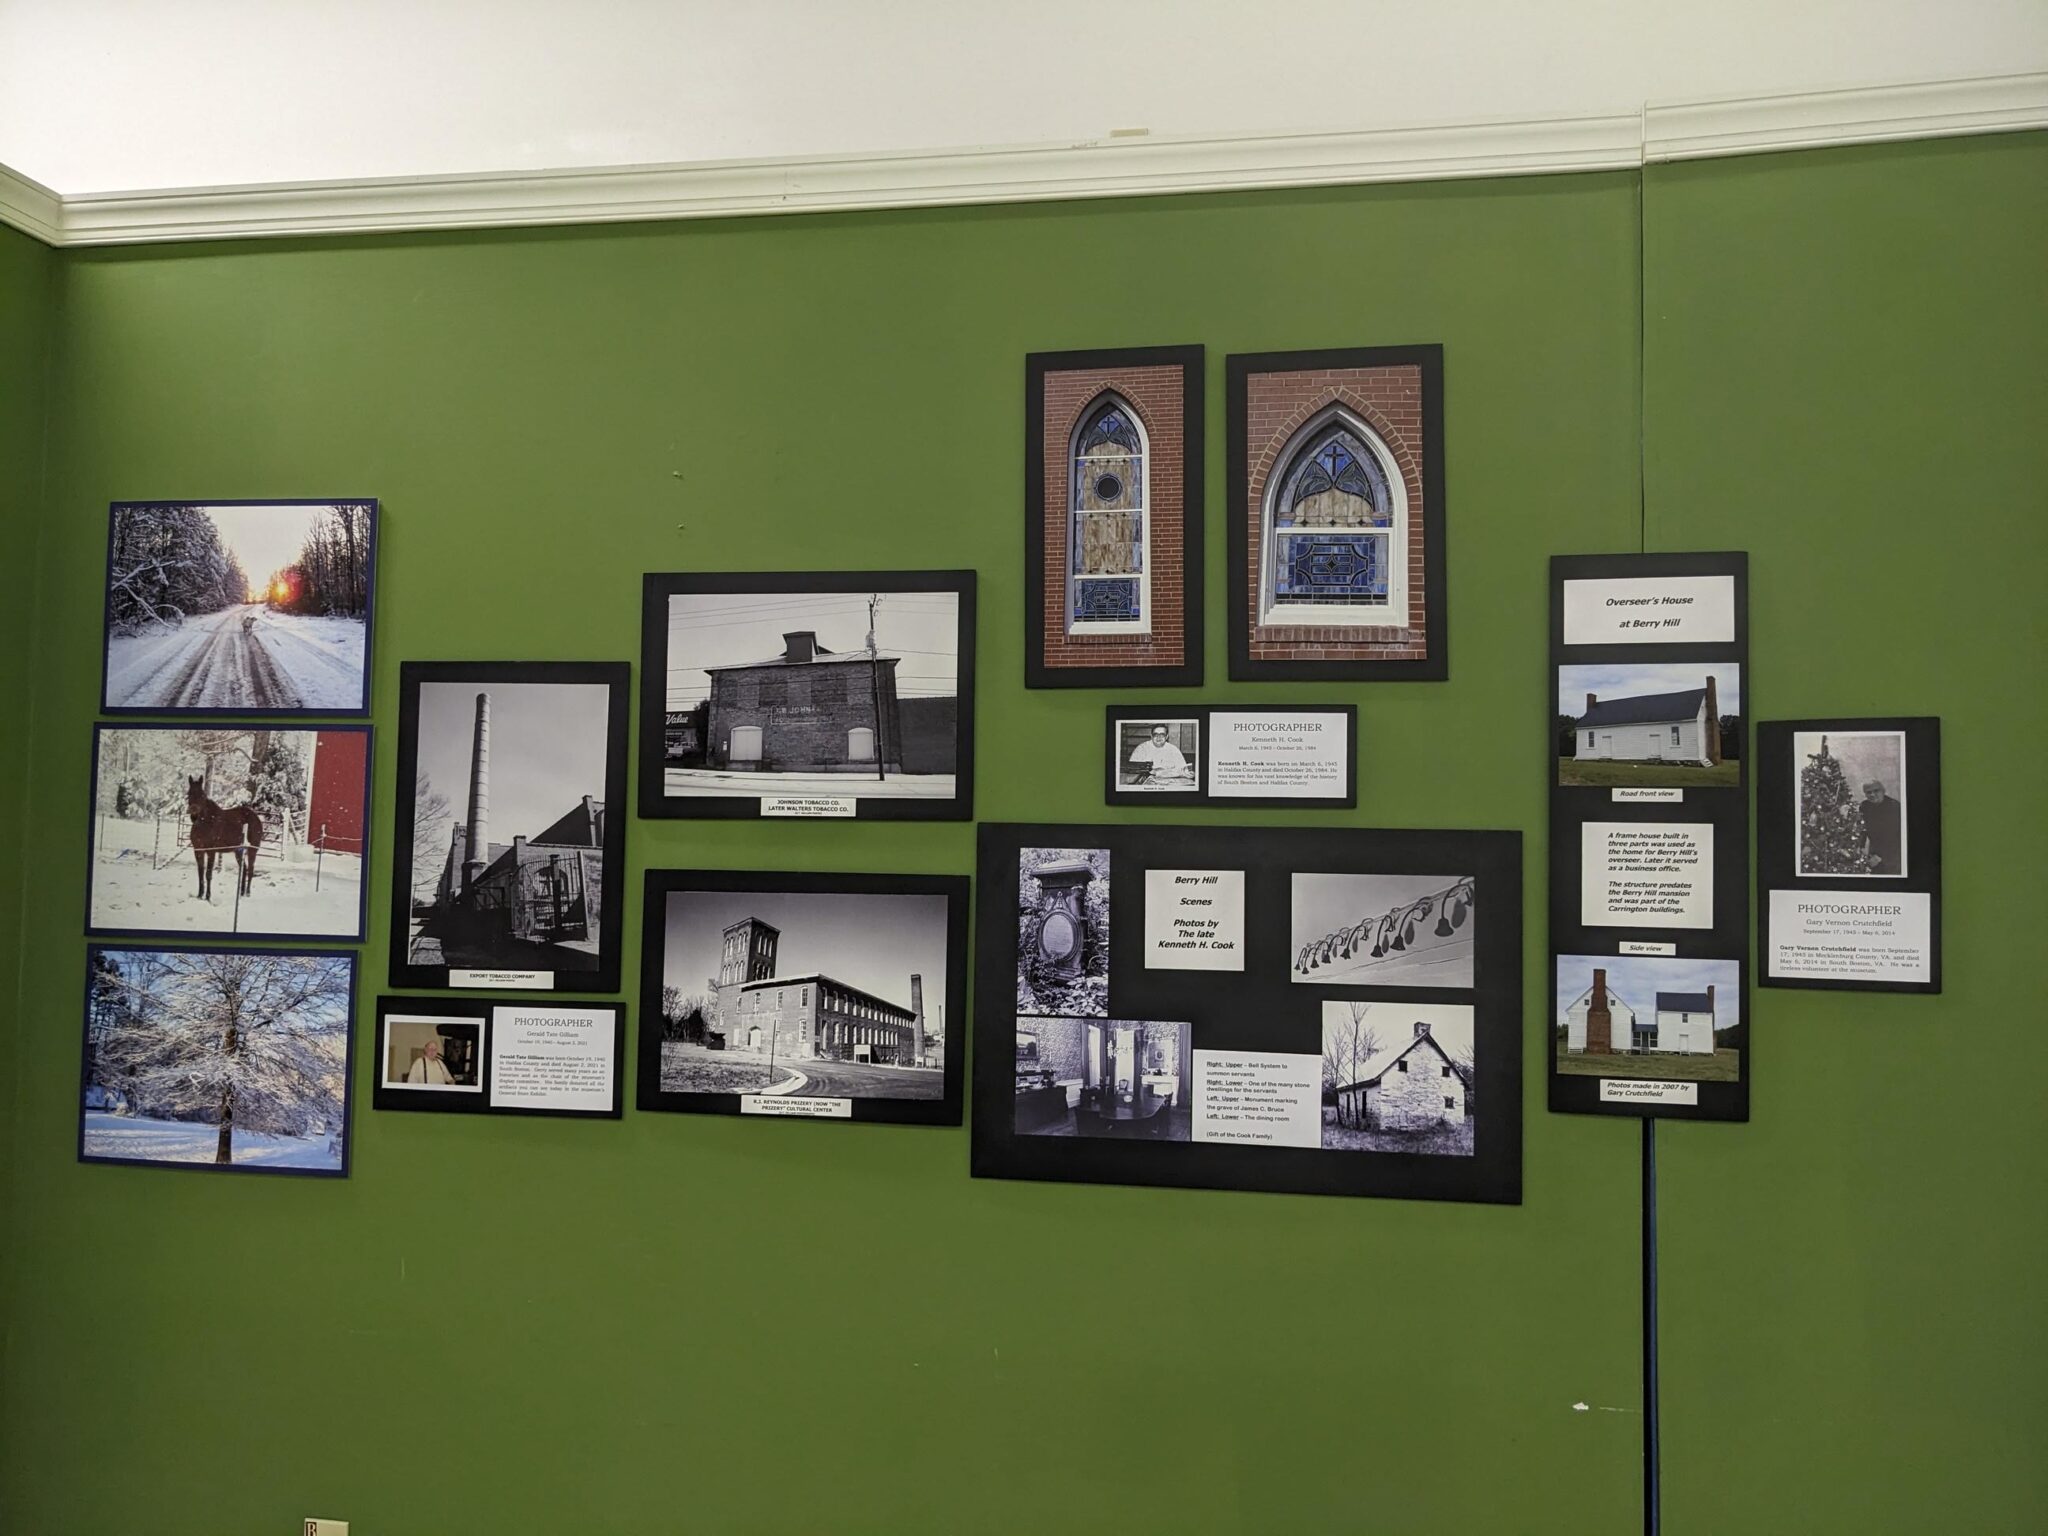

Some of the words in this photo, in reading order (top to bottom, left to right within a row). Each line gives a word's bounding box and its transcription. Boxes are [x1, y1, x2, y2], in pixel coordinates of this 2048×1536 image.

[1606, 597, 1659, 606] Overseer's
[1633, 620, 1660, 629] Berry
[1663, 619, 1681, 627] Hill
[1234, 724, 1322, 732] PHOTOGRAPHER
[1175, 876, 1200, 885] Berry
[1201, 876, 1218, 884] Hill
[1649, 906, 1685, 914] buildings.
[1798, 904, 1901, 915] PHOTOGRAPHER
[1173, 919, 1205, 927] Photos
[1207, 920, 1219, 928] by
[1179, 930, 1194, 938] The
[1197, 930, 1215, 938] late
[1199, 941, 1208, 949] H.
[1211, 941, 1235, 949] Cook
[514, 1018, 593, 1027] PHOTOGRAPHER
